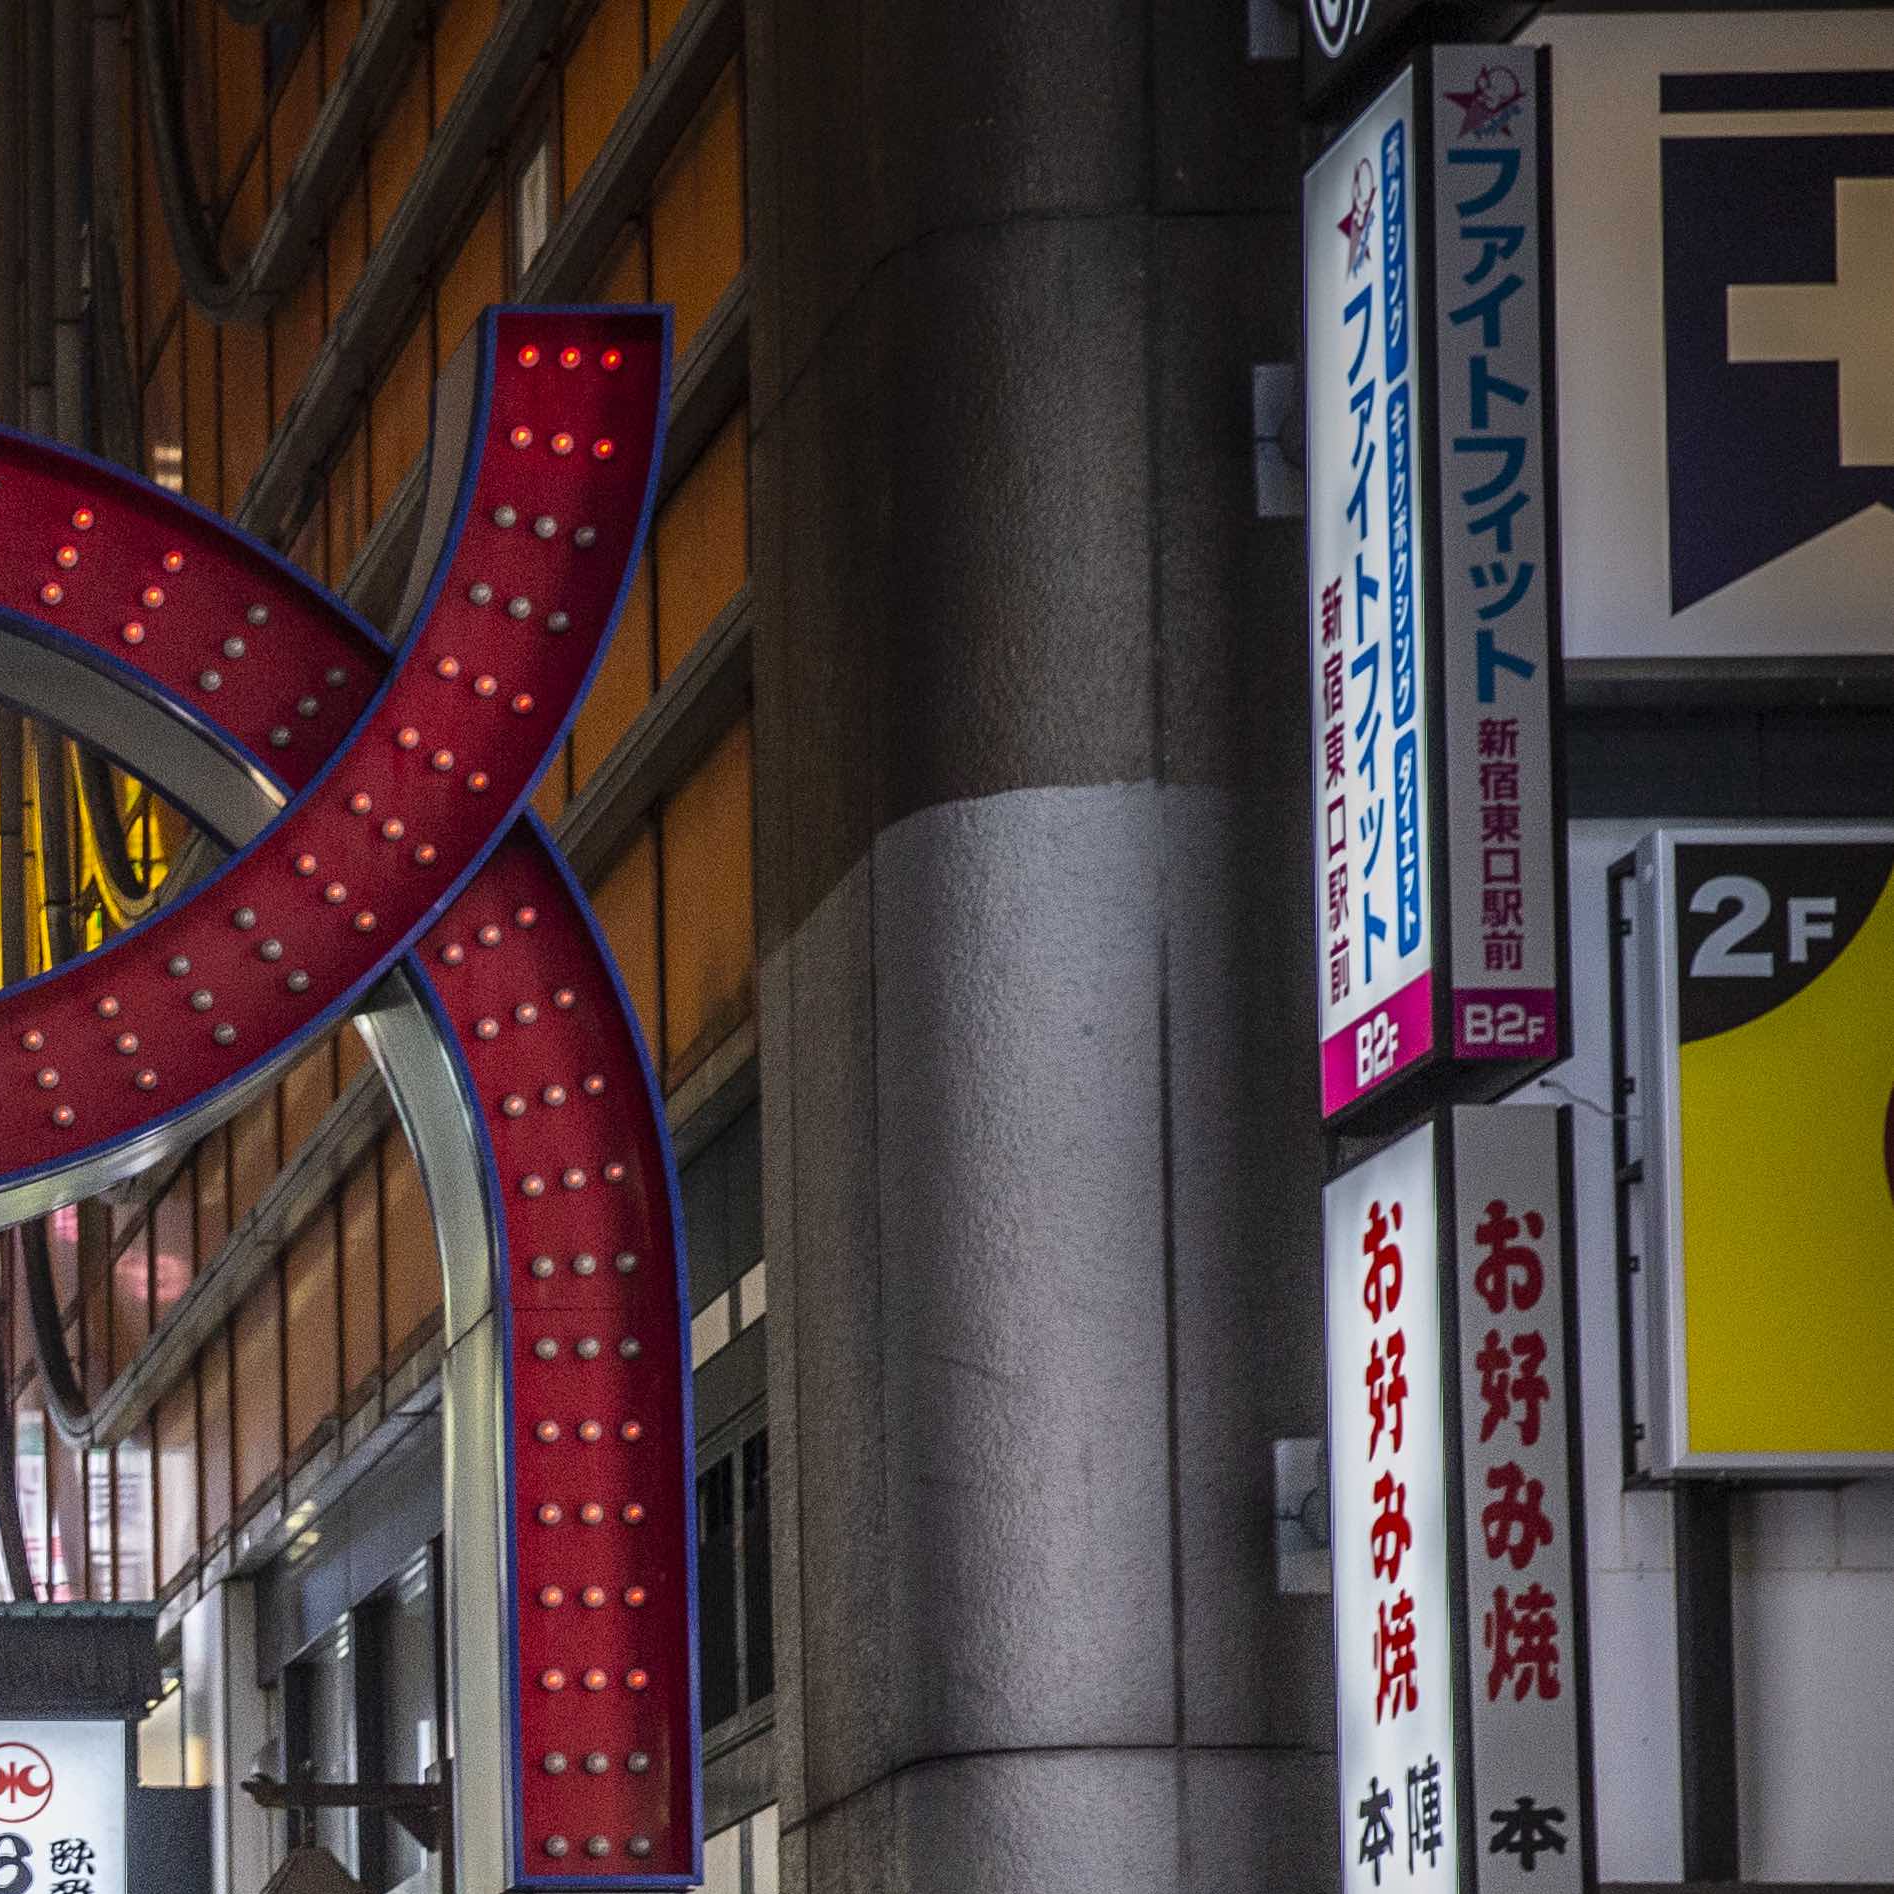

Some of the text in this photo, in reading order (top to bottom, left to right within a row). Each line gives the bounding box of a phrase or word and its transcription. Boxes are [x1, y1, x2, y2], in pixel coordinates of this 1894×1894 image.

[1343, 282, 1388, 986] ファイトフィット
[1448, 148, 1536, 704] ファイトフィット
[1321, 576, 1350, 1006] 新宿東口駅前
[1478, 718, 1524, 972] 新宿東口駅前
[1688, 876, 1838, 980] 2F
[1356, 1010, 1400, 1090] B2F
[1464, 1004, 1546, 1046] B2F
[1362, 1200, 1420, 1726] お好み焼
[1474, 1200, 1561, 1704] お好み焼
